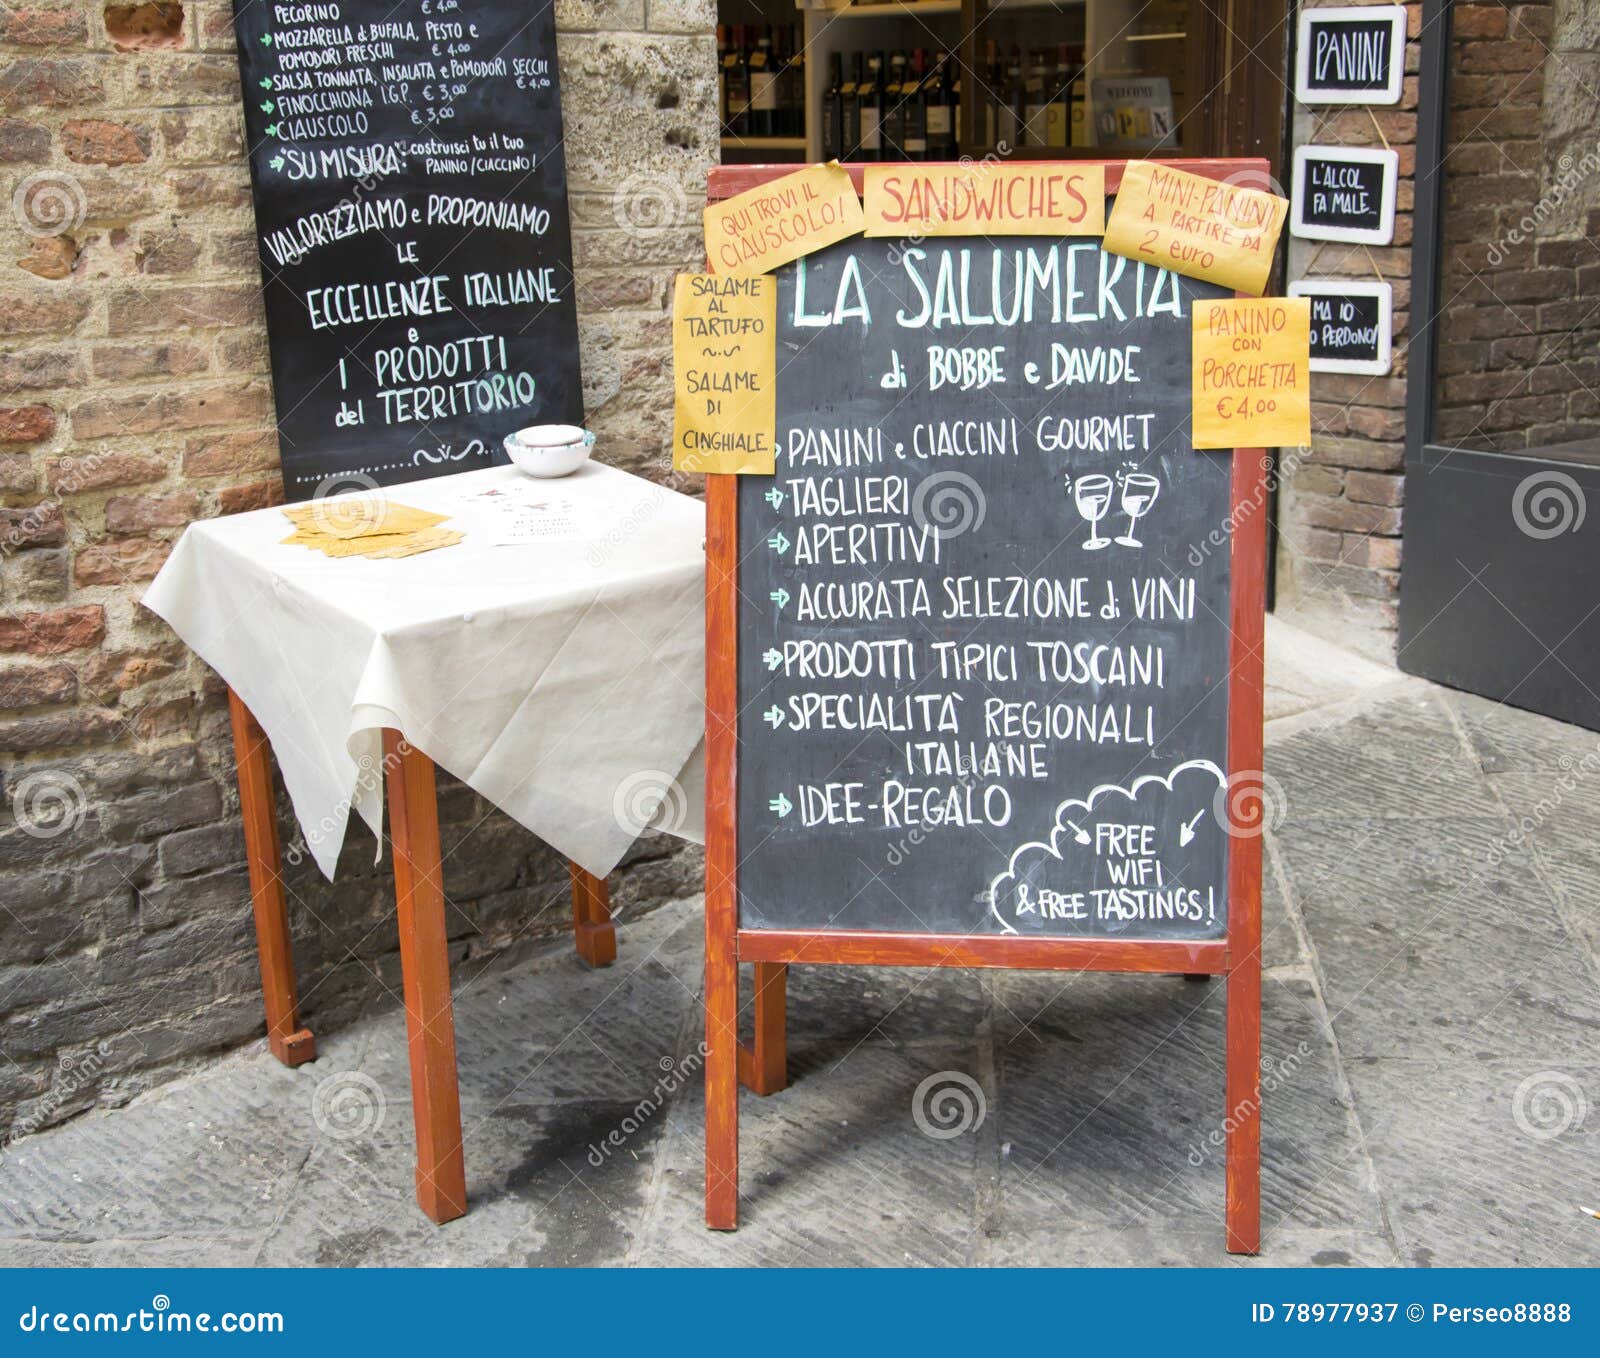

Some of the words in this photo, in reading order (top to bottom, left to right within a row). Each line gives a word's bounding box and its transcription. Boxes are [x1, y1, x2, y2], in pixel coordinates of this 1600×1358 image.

[274, 3, 340, 25] PECORINO
[421, 0, 432, 15] €
[273, 24, 353, 50] MOZZARELLA
[369, 21, 419, 42] BUFALA,
[425, 21, 463, 41] PESTO
[469, 24, 480, 38] e
[278, 47, 341, 71] POMODORI
[346, 42, 395, 63] FRESCHI
[432, 43, 442, 57] €
[1314, 29, 1386, 82] PANINI
[272, 71, 312, 92] SALSA
[314, 67, 377, 88] TONNATA,
[382, 62, 436, 83] INSALATA
[440, 65, 450, 79] e
[450, 57, 507, 79] POMODORI
[516, 76, 526, 89] €
[276, 88, 373, 118] FINOCCHIONA
[422, 85, 435, 101] €
[276, 111, 369, 142] CIAUSCOLO
[411, 109, 422, 125] €
[410, 138, 470, 157] costruisci
[472, 133, 487, 151] tu
[490, 132, 500, 150] il
[502, 134, 525, 151] tuo
[1312, 162, 1365, 189] L'ALCOL
[720, 209, 752, 237] QUI
[751, 189, 799, 216] TROVI
[803, 181, 819, 201] IL
[880, 174, 1089, 224] SANDWICHES
[1146, 168, 1276, 233] MINI-PANINI
[1313, 192, 1328, 215] FA
[263, 197, 407, 267] VALORIZZIAMO
[411, 208, 422, 224] e
[427, 194, 550, 236] PROPONIAMO
[719, 196, 847, 269] CIAUSCOLO!
[1142, 206, 1155, 223] A
[1170, 209, 1233, 246] PARTIRE
[1240, 235, 1262, 252] DA
[396, 241, 420, 264] LE
[1138, 229, 1160, 255] 2
[1169, 239, 1215, 270] euro
[306, 275, 453, 330] ECCELLENZE
[463, 267, 561, 308] ITALIANE
[690, 276, 762, 298] SALAME
[793, 254, 872, 328] LA
[707, 298, 729, 314] AL
[1208, 305, 1287, 335] PANINO
[1313, 300, 1332, 321] MA
[1339, 302, 1355, 322] IO
[407, 326, 420, 343] e
[682, 317, 765, 338] TARTUFO
[1232, 336, 1262, 351] CON
[1322, 323, 1379, 350] PERDONO!
[338, 358, 348, 390] I
[375, 334, 508, 387] PRODOTTI
[880, 350, 908, 388] di
[926, 346, 1007, 390] BOBBE
[1023, 361, 1041, 384] e
[1045, 343, 1142, 390] DAVIDE
[1202, 358, 1297, 391] PORCHETTA
[686, 369, 761, 394] SALAME
[335, 399, 365, 428] del
[375, 371, 536, 425] TERRITORIO
[706, 400, 722, 416] DI
[682, 429, 768, 453] CINGHIALE
[788, 427, 883, 468] PANINI
[894, 442, 907, 460] e
[912, 420, 1019, 459] CIACCINI
[1036, 413, 1156, 452] GOURMET
[786, 475, 909, 518] TAGLIERI
[795, 523, 940, 565] APERITIVI
[797, 577, 932, 622] ACCURATA
[942, 576, 1092, 619] SELEZIONE
[1100, 580, 1120, 620] di
[1132, 576, 1196, 620] VINI
[783, 638, 917, 680] PRODOTTI
[931, 641, 1019, 682] TIPICI
[1026, 640, 1165, 688] TOSCANI
[788, 692, 964, 735] SPECIALITÀ
[984, 697, 1154, 747] REGIONALI
[906, 740, 1049, 778] ITALIANE
[798, 779, 1013, 828] IDEE-REGALO
[1096, 822, 1157, 857] FREE
[1107, 858, 1164, 887] WIFI
[1015, 883, 1037, 916] &
[1037, 888, 1089, 920] FREE
